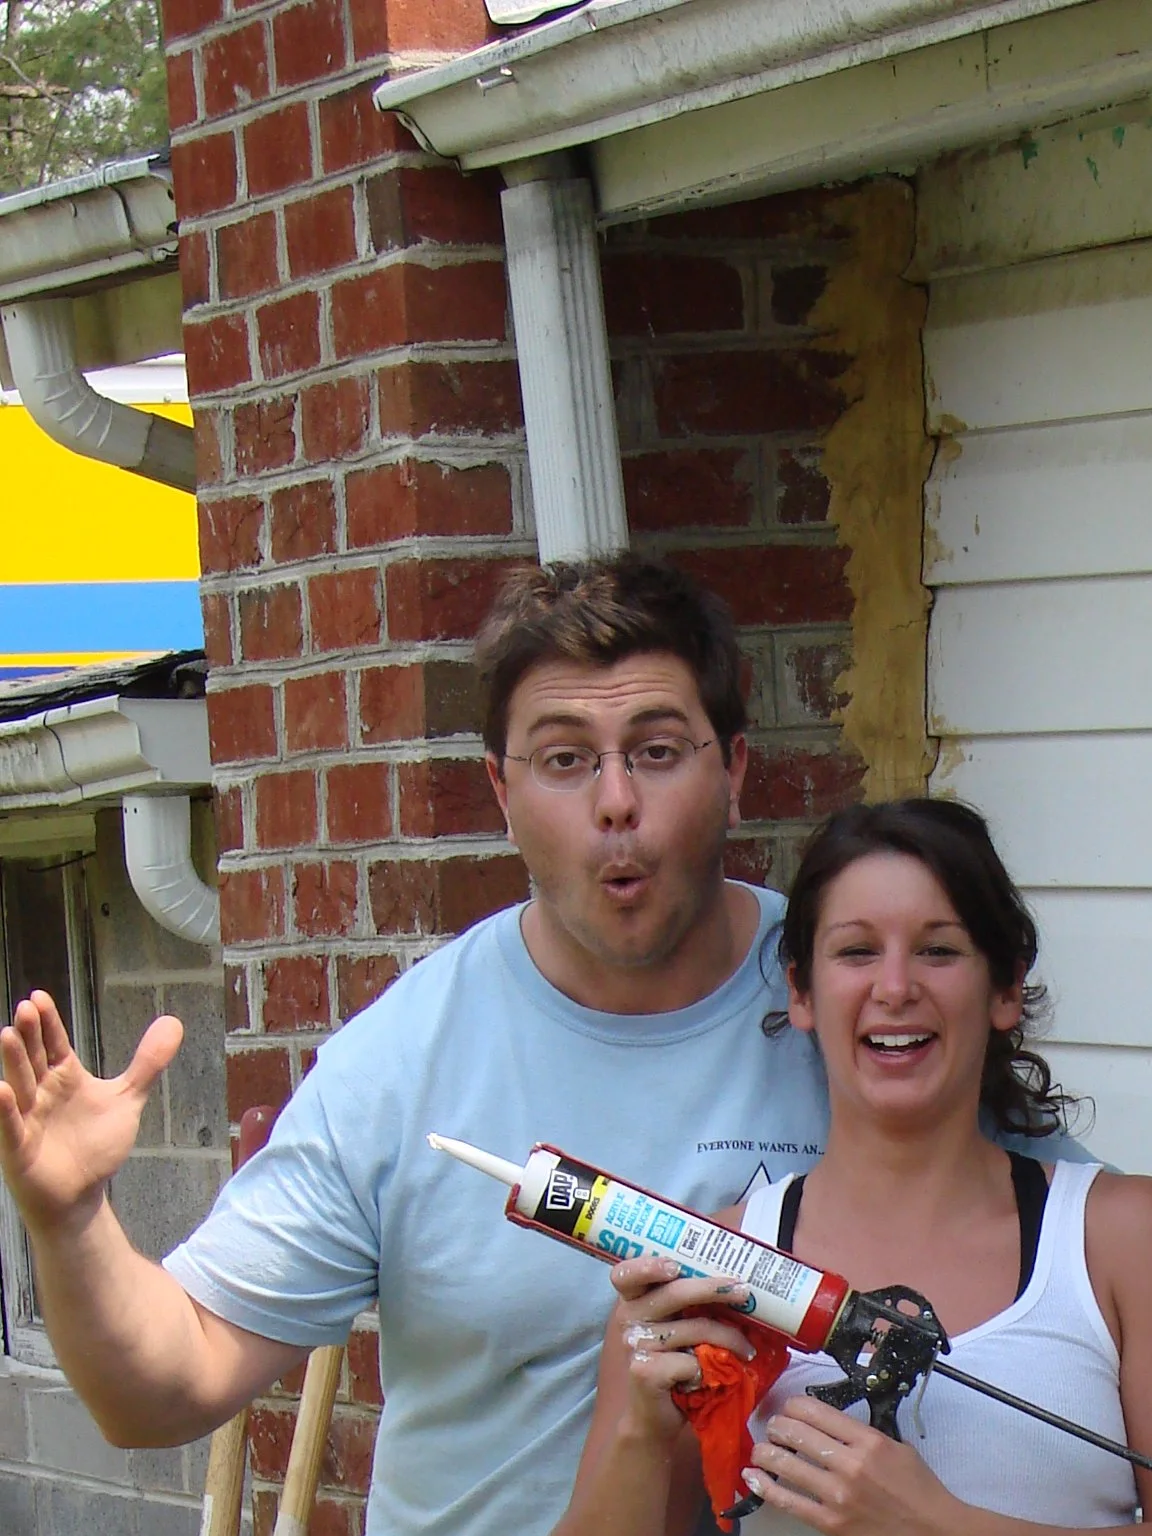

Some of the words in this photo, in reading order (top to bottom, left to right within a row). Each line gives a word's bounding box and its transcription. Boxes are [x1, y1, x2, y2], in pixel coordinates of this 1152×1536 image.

[697, 1140, 755, 1153] EVERYONE
[758, 1142, 798, 1154] WANTS
[550, 1173, 573, 1207] DAP
[605, 1192, 625, 1224] ACRYLIC
[614, 1202, 630, 1228] LATEX
[633, 1203, 654, 1236] SILICONE
